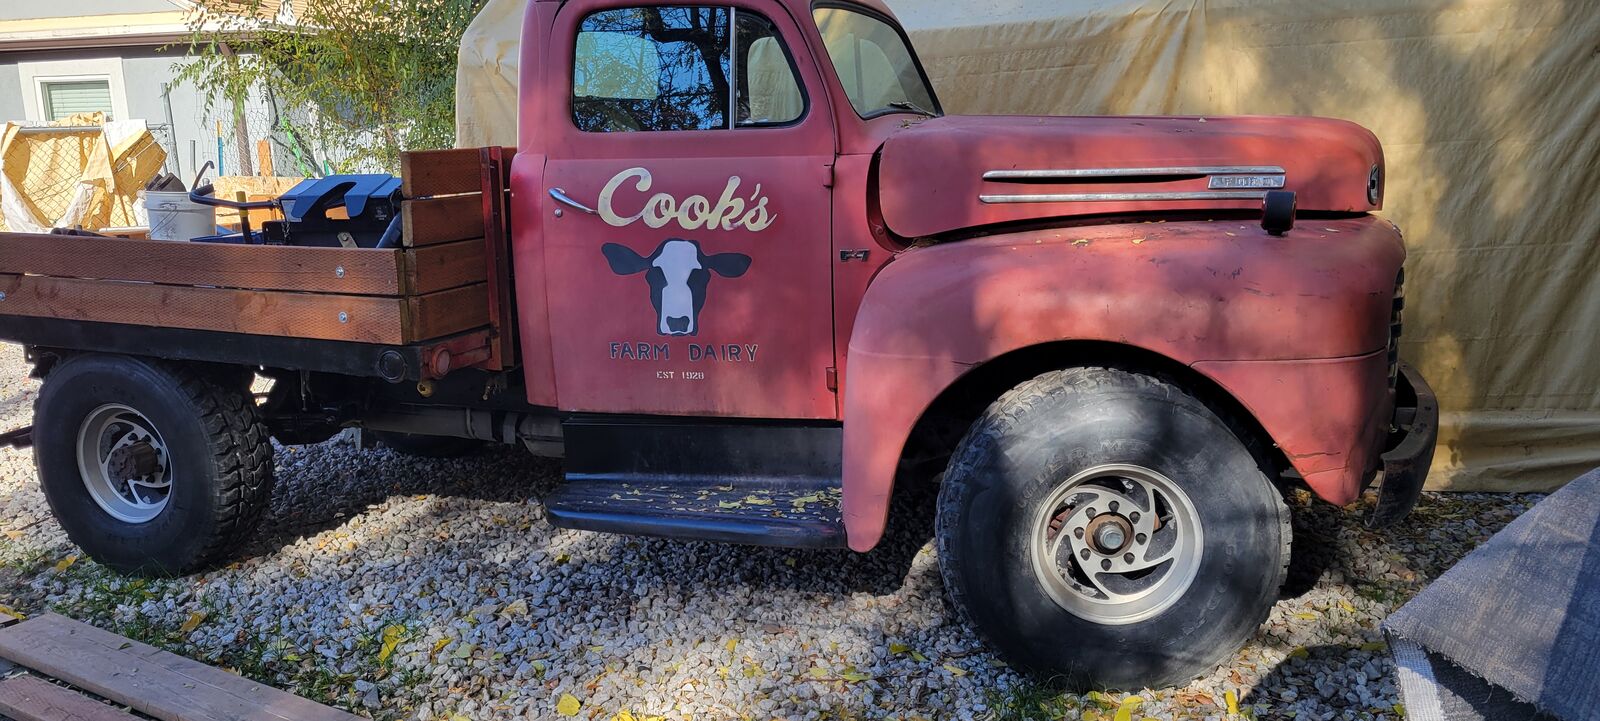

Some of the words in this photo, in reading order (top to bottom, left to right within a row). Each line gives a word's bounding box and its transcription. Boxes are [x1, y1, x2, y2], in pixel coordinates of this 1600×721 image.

[598, 167, 777, 231] Cook's
[609, 342, 670, 360] FARM
[688, 344, 758, 361] DAIRY
[656, 371, 674, 379] EST
[681, 371, 704, 380] 1928
